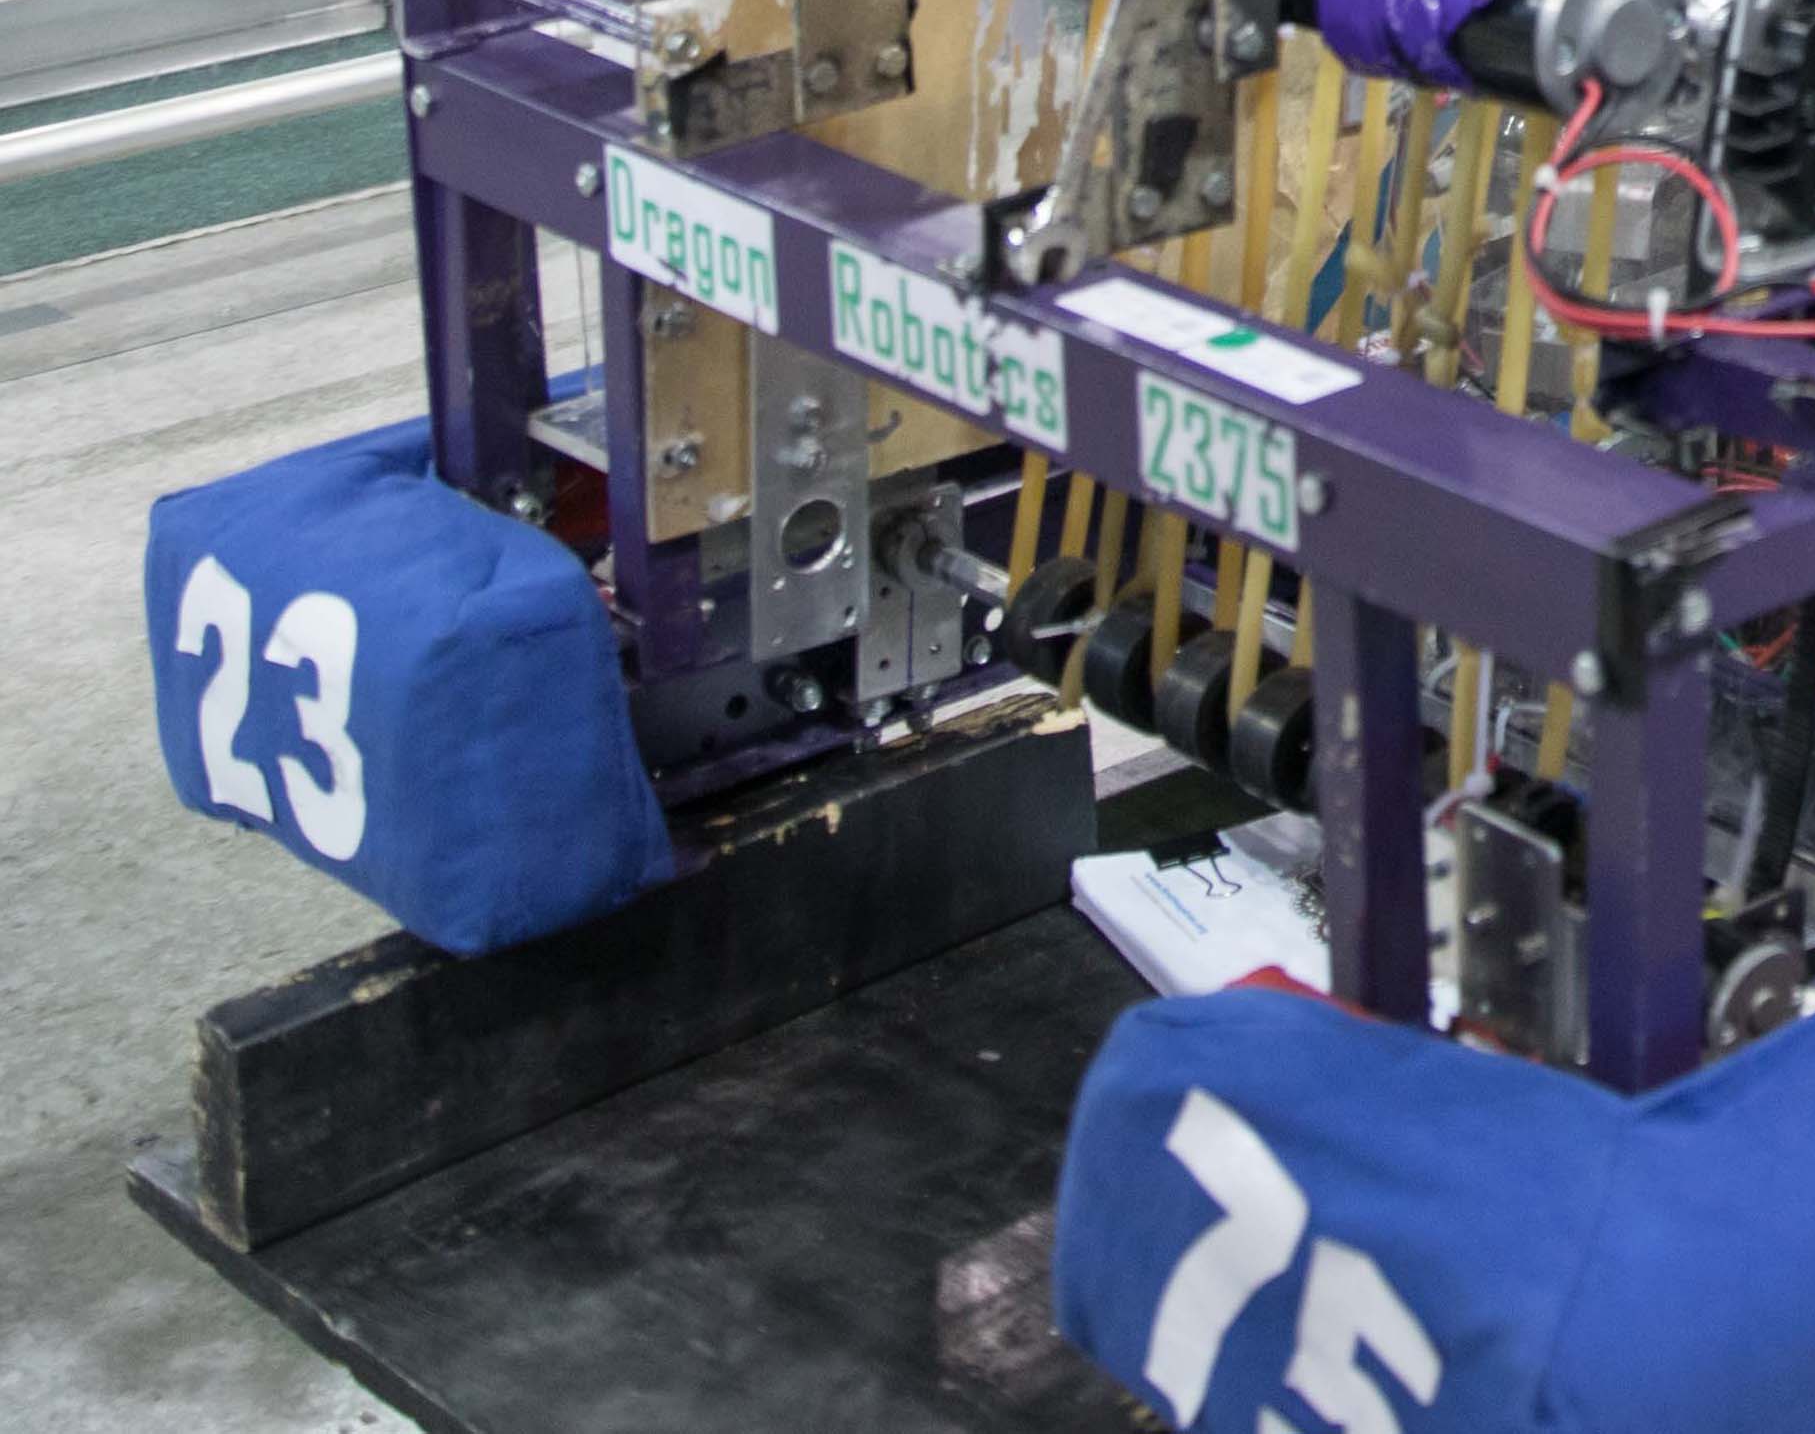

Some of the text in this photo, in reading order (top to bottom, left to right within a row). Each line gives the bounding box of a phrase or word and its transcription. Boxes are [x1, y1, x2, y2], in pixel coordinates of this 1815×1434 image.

[611, 156, 1289, 535] Dragon Robotcs 2375
[176, 554, 366, 862] 23
[1142, 1086, 1444, 1434] 75
